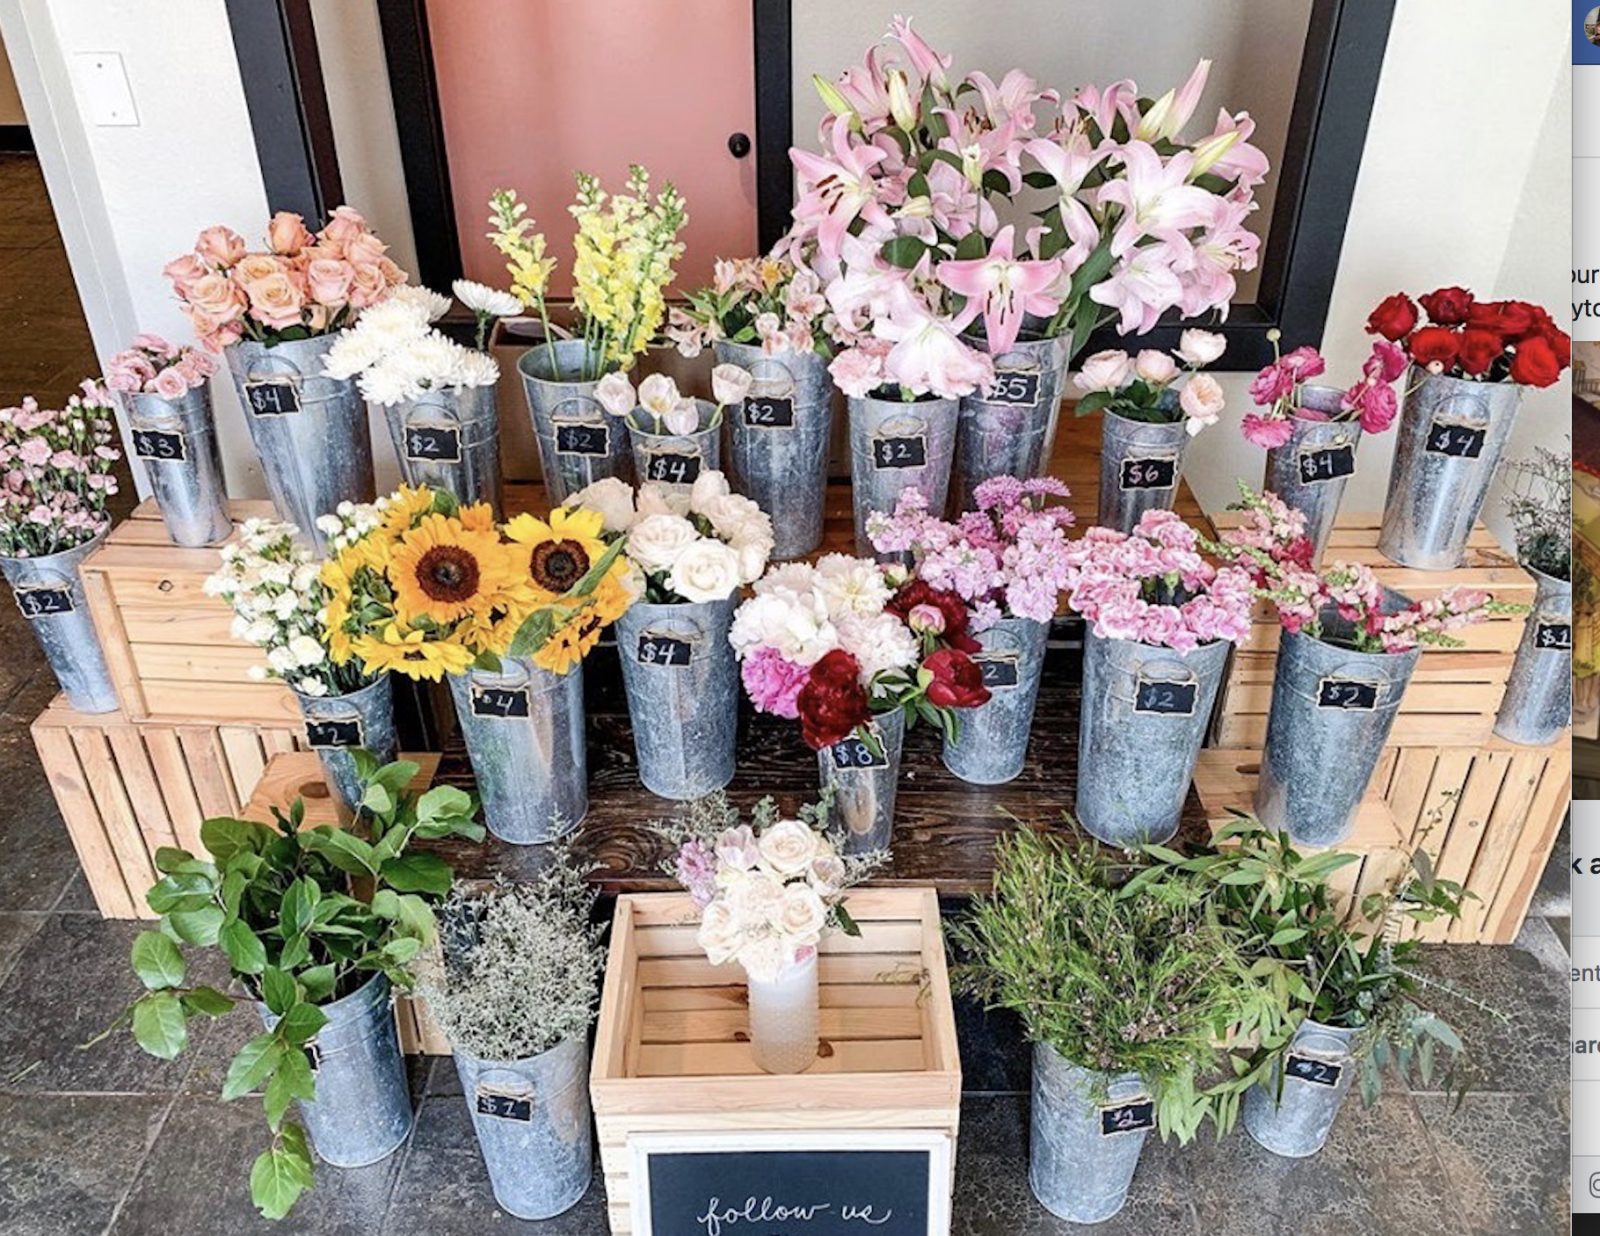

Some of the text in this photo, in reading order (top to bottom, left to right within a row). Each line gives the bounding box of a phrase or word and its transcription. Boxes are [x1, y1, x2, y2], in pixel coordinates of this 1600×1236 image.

[992, 376, 1028, 399] $5
[253, 388, 281, 411] $4
[748, 402, 775, 423] $2
[139, 435, 175, 457] $3
[411, 433, 439, 455] $2
[565, 430, 593, 450] $2
[1435, 430, 1474, 457] $4
[882, 443, 911, 463] $2
[653, 459, 686, 482] $4
[1129, 465, 1159, 484] $6
[1302, 453, 1333, 476] $4
[26, 594, 61, 614] $2
[1542, 629, 1571, 647] $1
[641, 642, 676, 665] $4
[1144, 687, 1174, 709] $2
[1328, 686, 1361, 707] $2
[836, 743, 873, 765] $8
[697, 1196, 891, 1236] follow us
